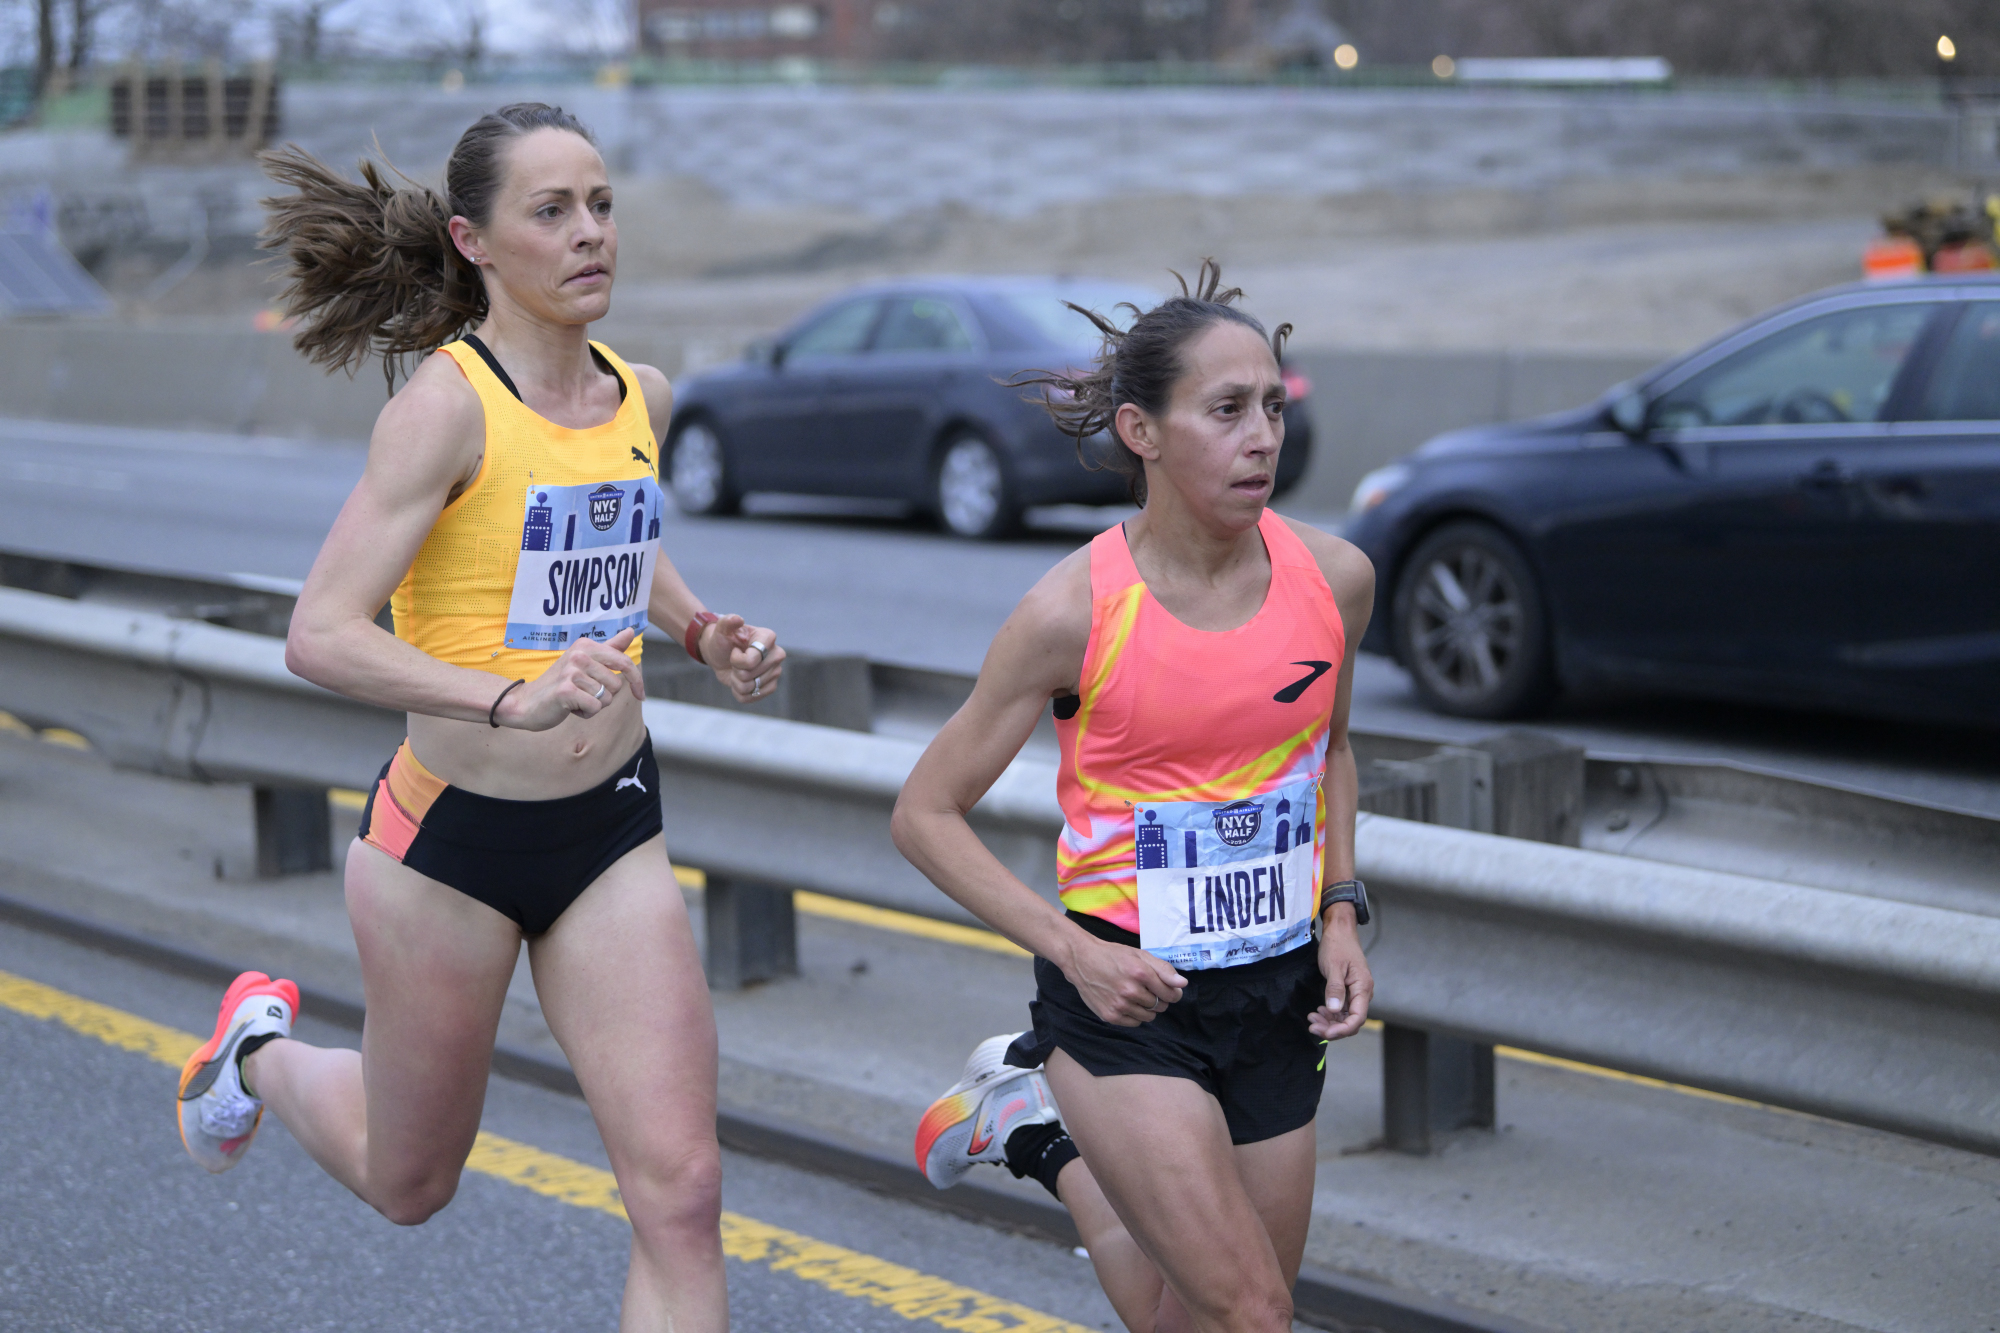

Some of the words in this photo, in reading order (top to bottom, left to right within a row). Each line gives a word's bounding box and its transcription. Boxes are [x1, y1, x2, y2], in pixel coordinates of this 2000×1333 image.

[593, 499, 617, 514] NYC
[594, 512, 614, 524] HALF
[543, 551, 645, 617] SIMPSON
[1222, 813, 1255, 830] NYC
[1225, 827, 1253, 839] HALF
[1187, 862, 1286, 935] LINDEN
[1166, 956, 1199, 964] IRLINES
[1168, 951, 1198, 959] UNITED
